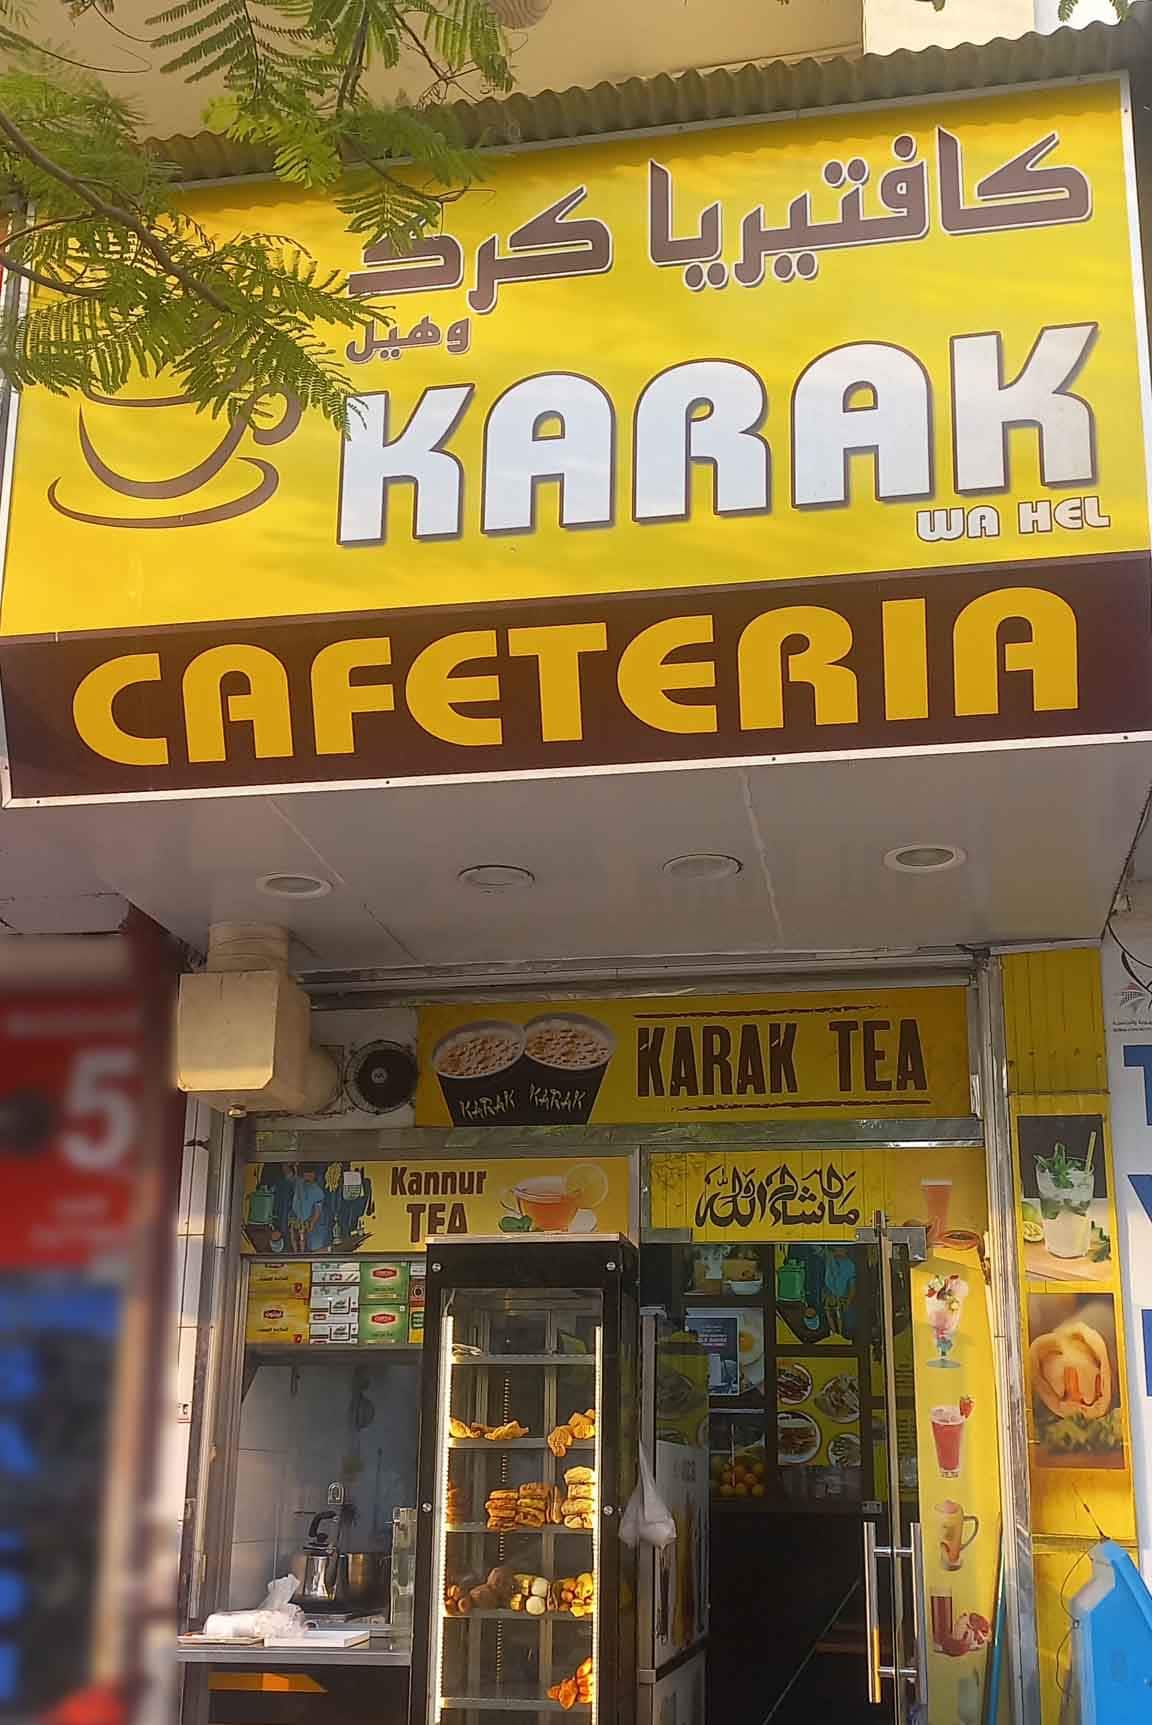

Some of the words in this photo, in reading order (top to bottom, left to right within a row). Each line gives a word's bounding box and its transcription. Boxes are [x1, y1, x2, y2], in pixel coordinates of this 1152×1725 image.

[649, 125, 1093, 293] كافتيريا
[348, 183, 613, 313] كرك
[336, 322, 1100, 546] KARAK
[915, 506, 1001, 544] WA
[1017, 496, 1112, 535] HEL
[72, 587, 1079, 766] CAFETERIA
[636, 1022, 799, 1099] KARAK
[829, 1019, 929, 1092] TEA
[459, 1089, 516, 1121] KARAK
[528, 1082, 587, 1113] KARAK
[390, 1165, 488, 1197] Kannur
[406, 1202, 470, 1243] TEA
